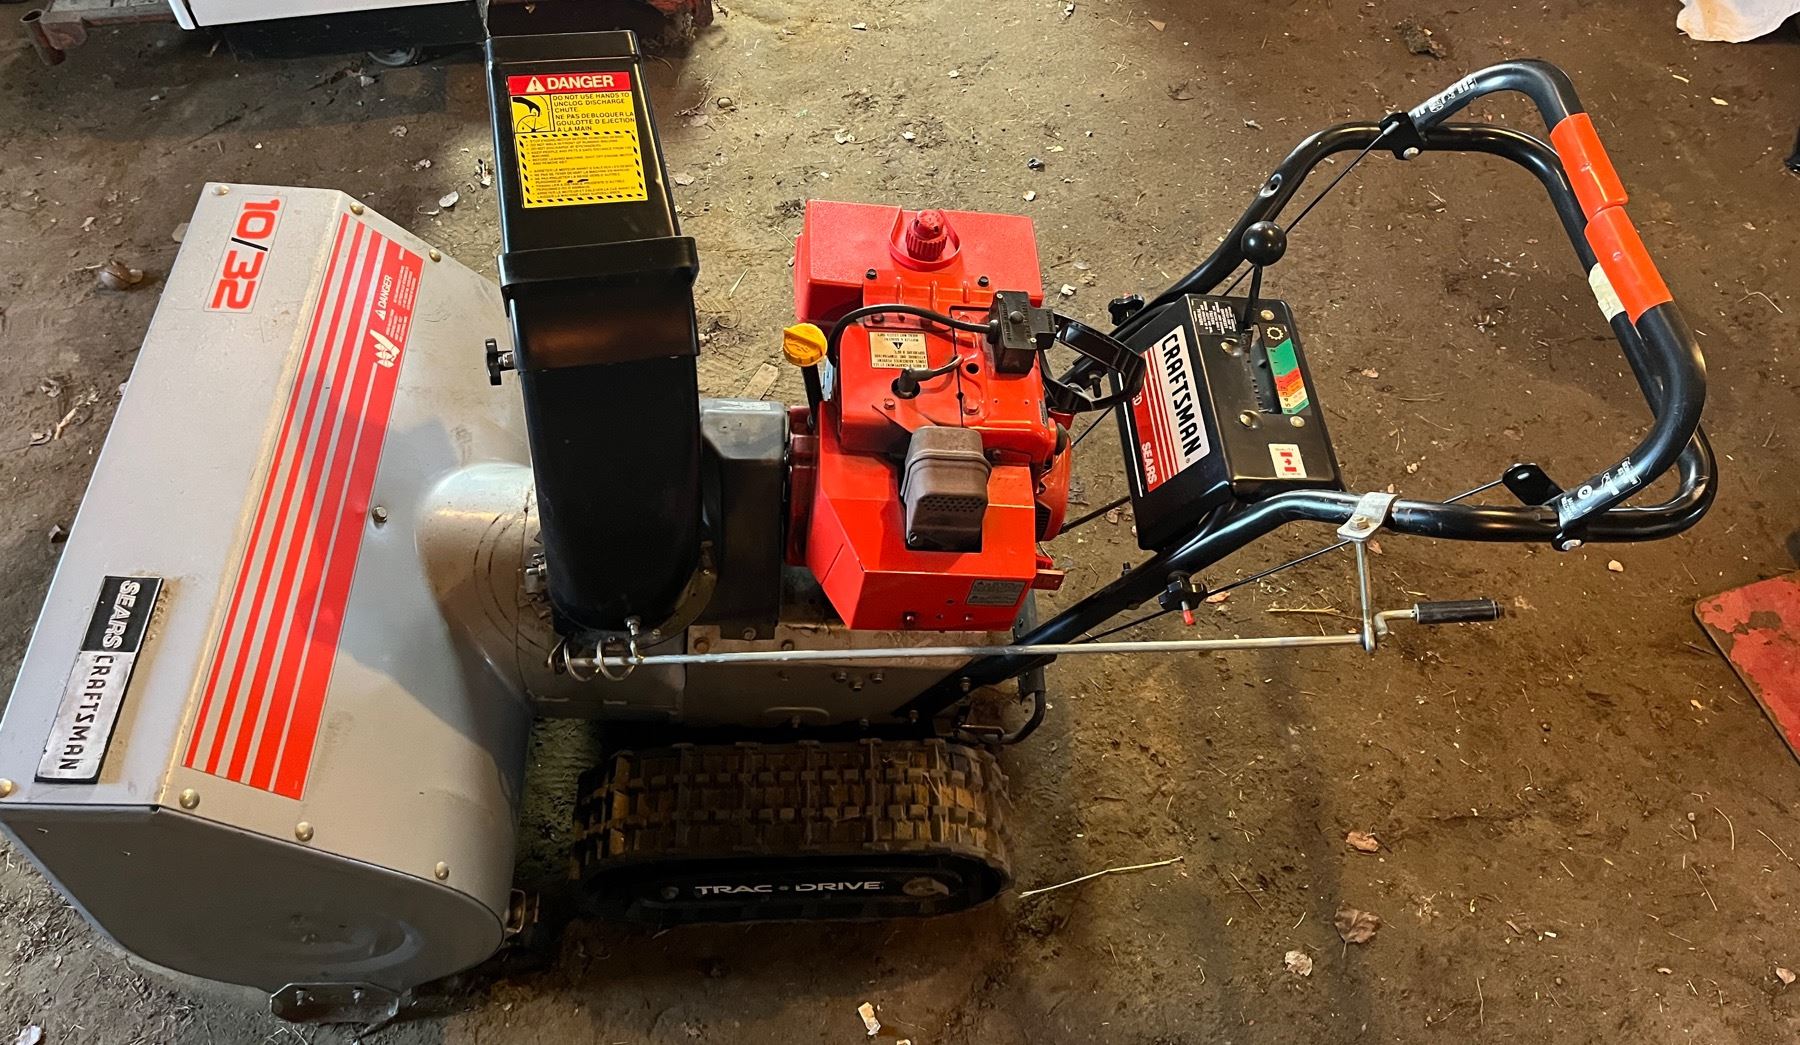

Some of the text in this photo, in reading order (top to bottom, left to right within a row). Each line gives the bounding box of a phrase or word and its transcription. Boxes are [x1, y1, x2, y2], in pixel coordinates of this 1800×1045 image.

[546, 75, 615, 90] DANGER
[211, 198, 280, 309] 10/32
[377, 274, 393, 309] DANGER
[1161, 333, 1201, 458] CRAFTSMAN
[1141, 441, 1158, 485] SEARS
[102, 579, 141, 650] SEARS
[58, 655, 114, 770] CRAFTSMAN
[695, 881, 881, 895] TRAC DRIVE
